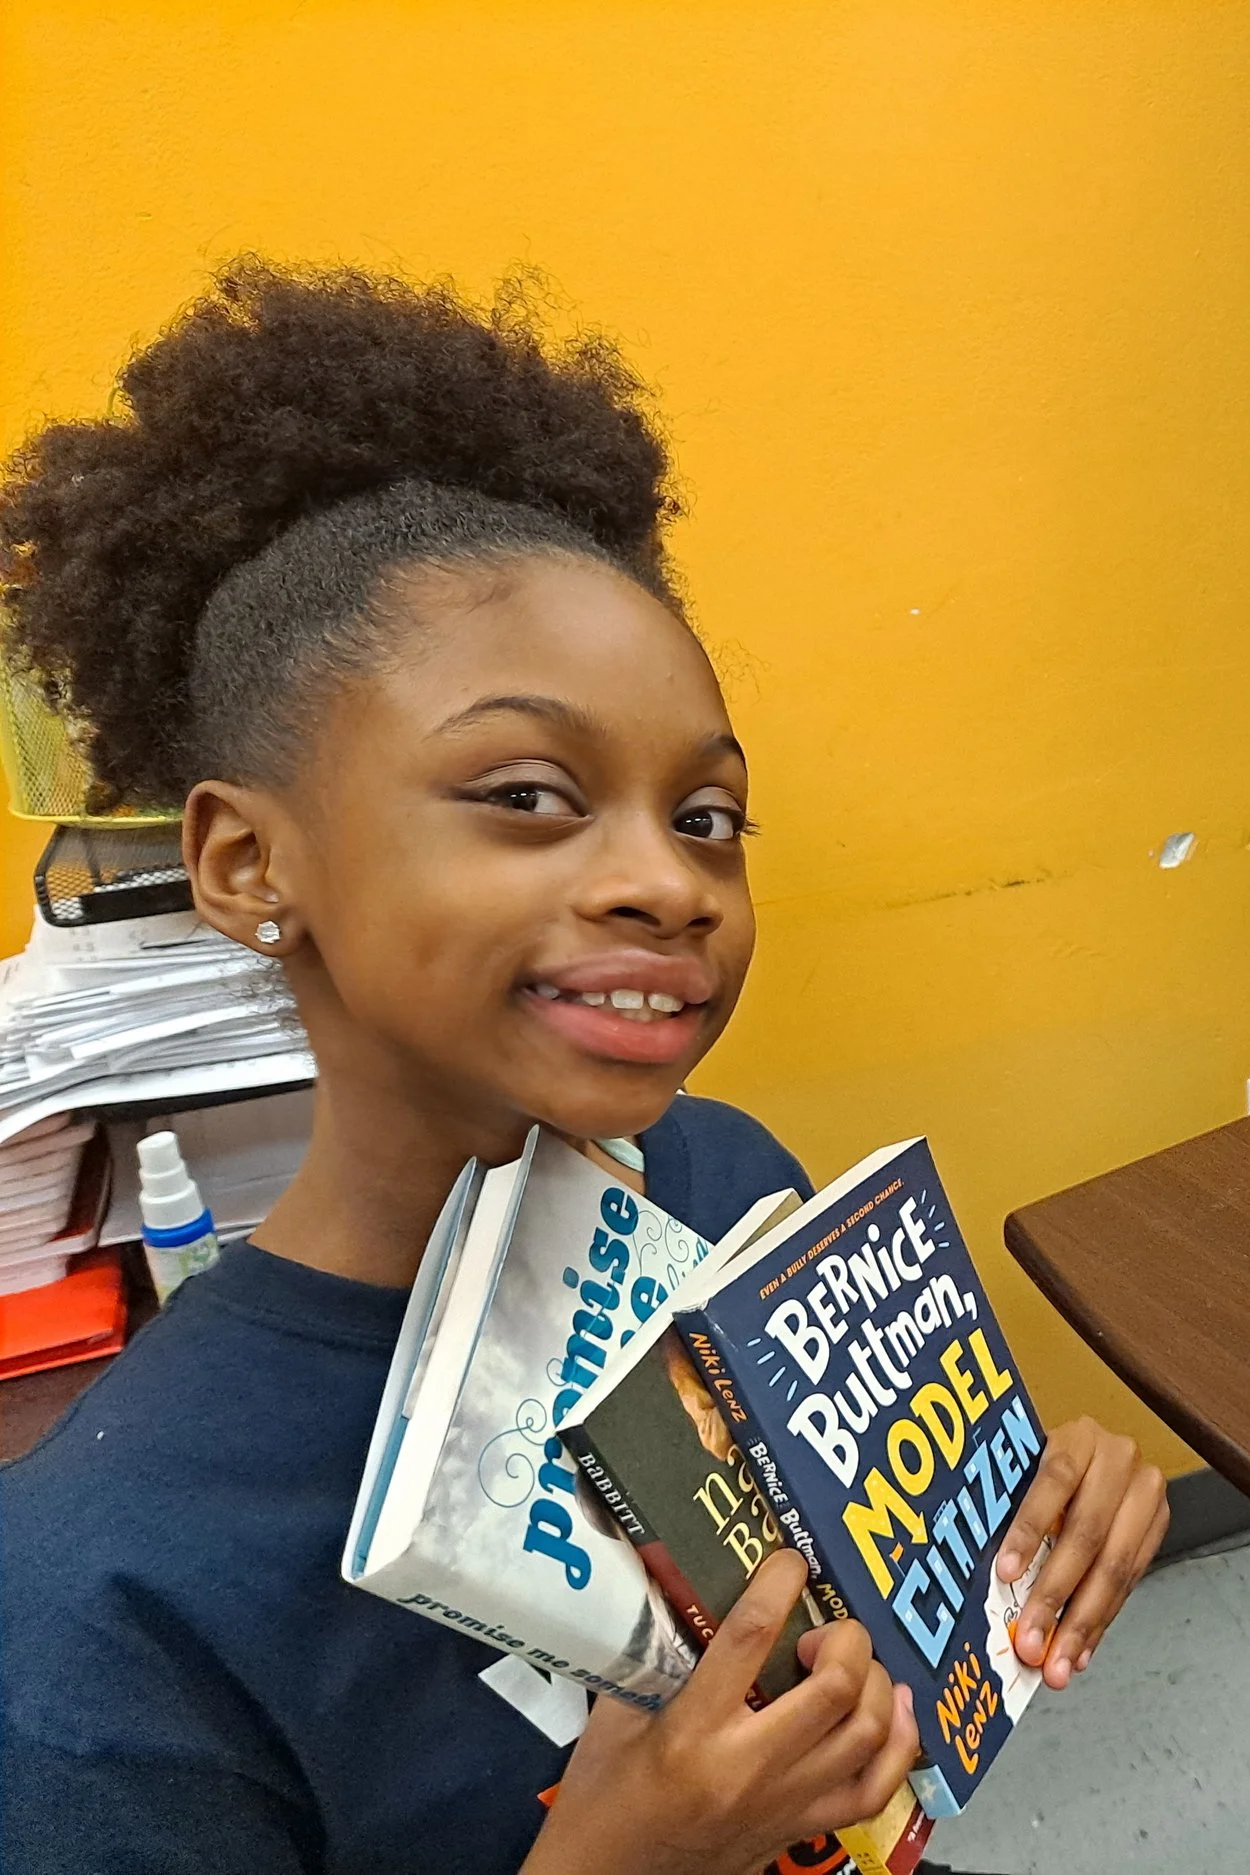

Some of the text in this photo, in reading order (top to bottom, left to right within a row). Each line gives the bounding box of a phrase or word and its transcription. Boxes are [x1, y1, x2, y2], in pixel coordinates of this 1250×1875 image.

[759, 1178, 905, 1300] EVEN A BULLY DESERVES A SECOND CHANCE.
[787, 1272, 979, 1488] Buttman,
[842, 1328, 1014, 1599] MODEL
[780, 1508, 822, 1579] Buttman,
[892, 1396, 1042, 1668] CITIZEN
[397, 1593, 525, 1649] promise
[527, 1648, 570, 1669] me
